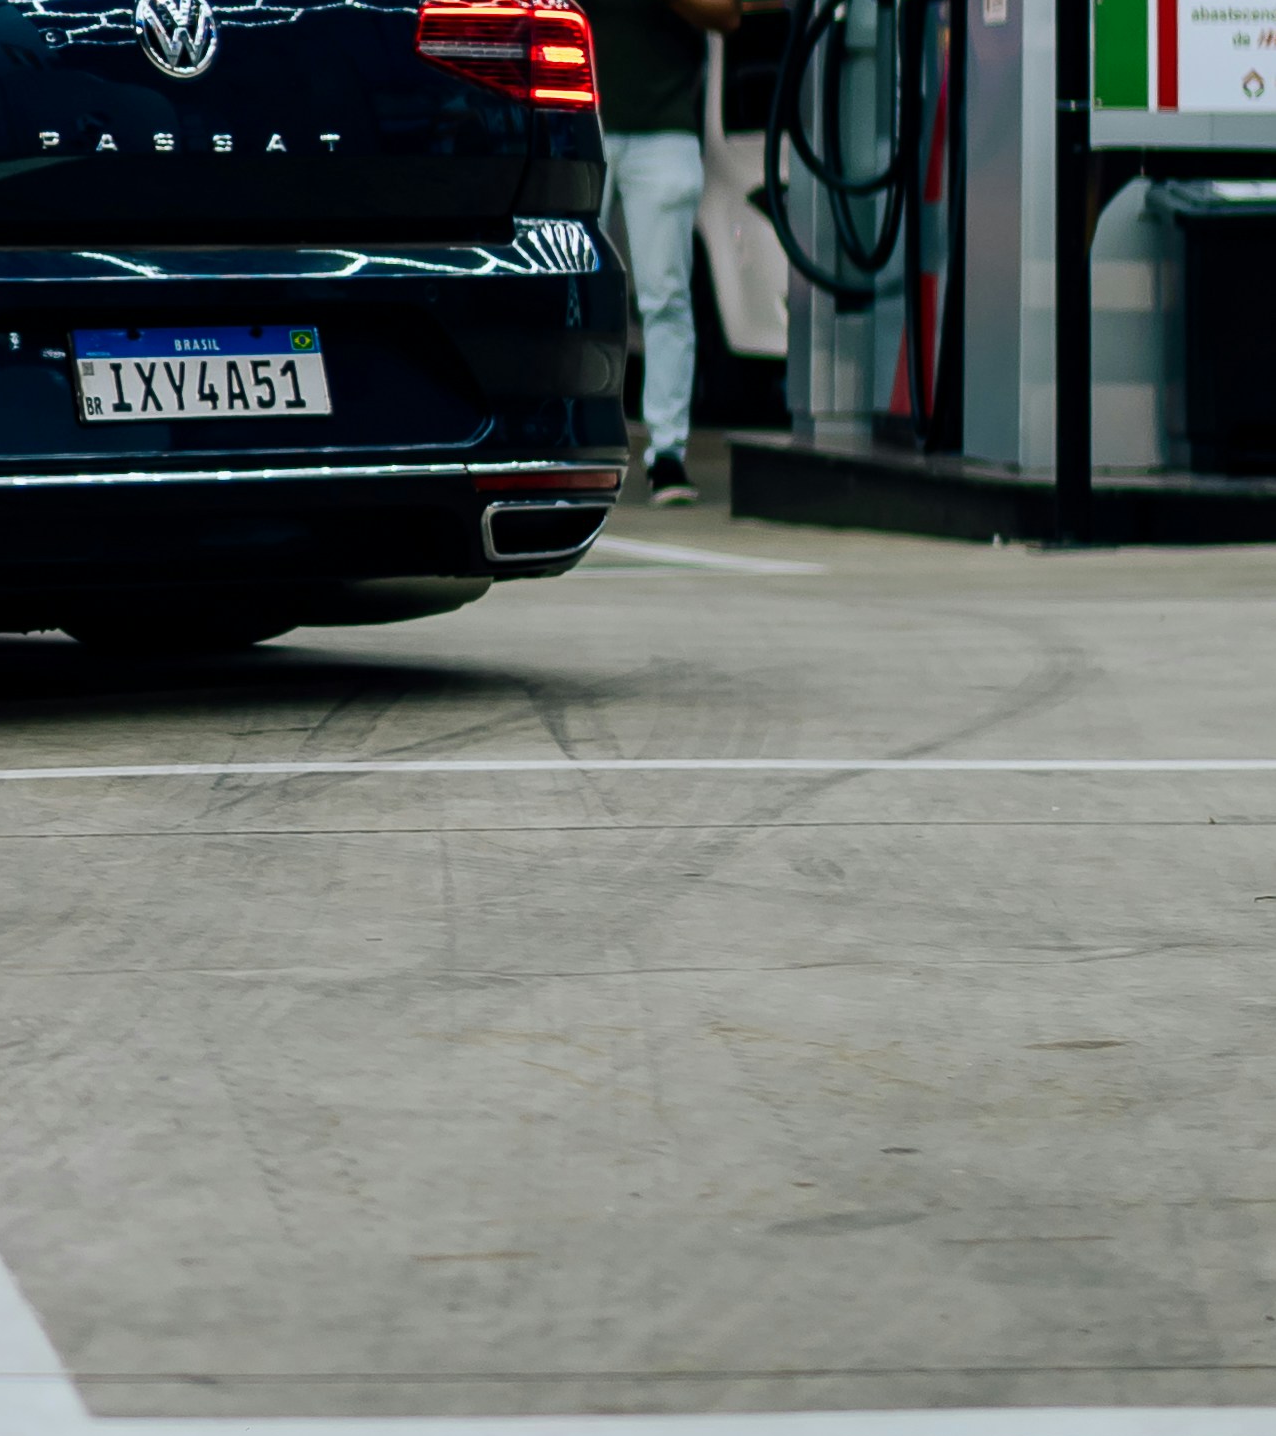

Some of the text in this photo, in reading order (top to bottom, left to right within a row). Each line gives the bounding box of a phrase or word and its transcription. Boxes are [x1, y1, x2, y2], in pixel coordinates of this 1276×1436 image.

[38, 131, 342, 153] PASSAT
[173, 338, 221, 352] BRASIL
[108, 359, 307, 413] IXY4A51
[85, 396, 105, 416] BR
